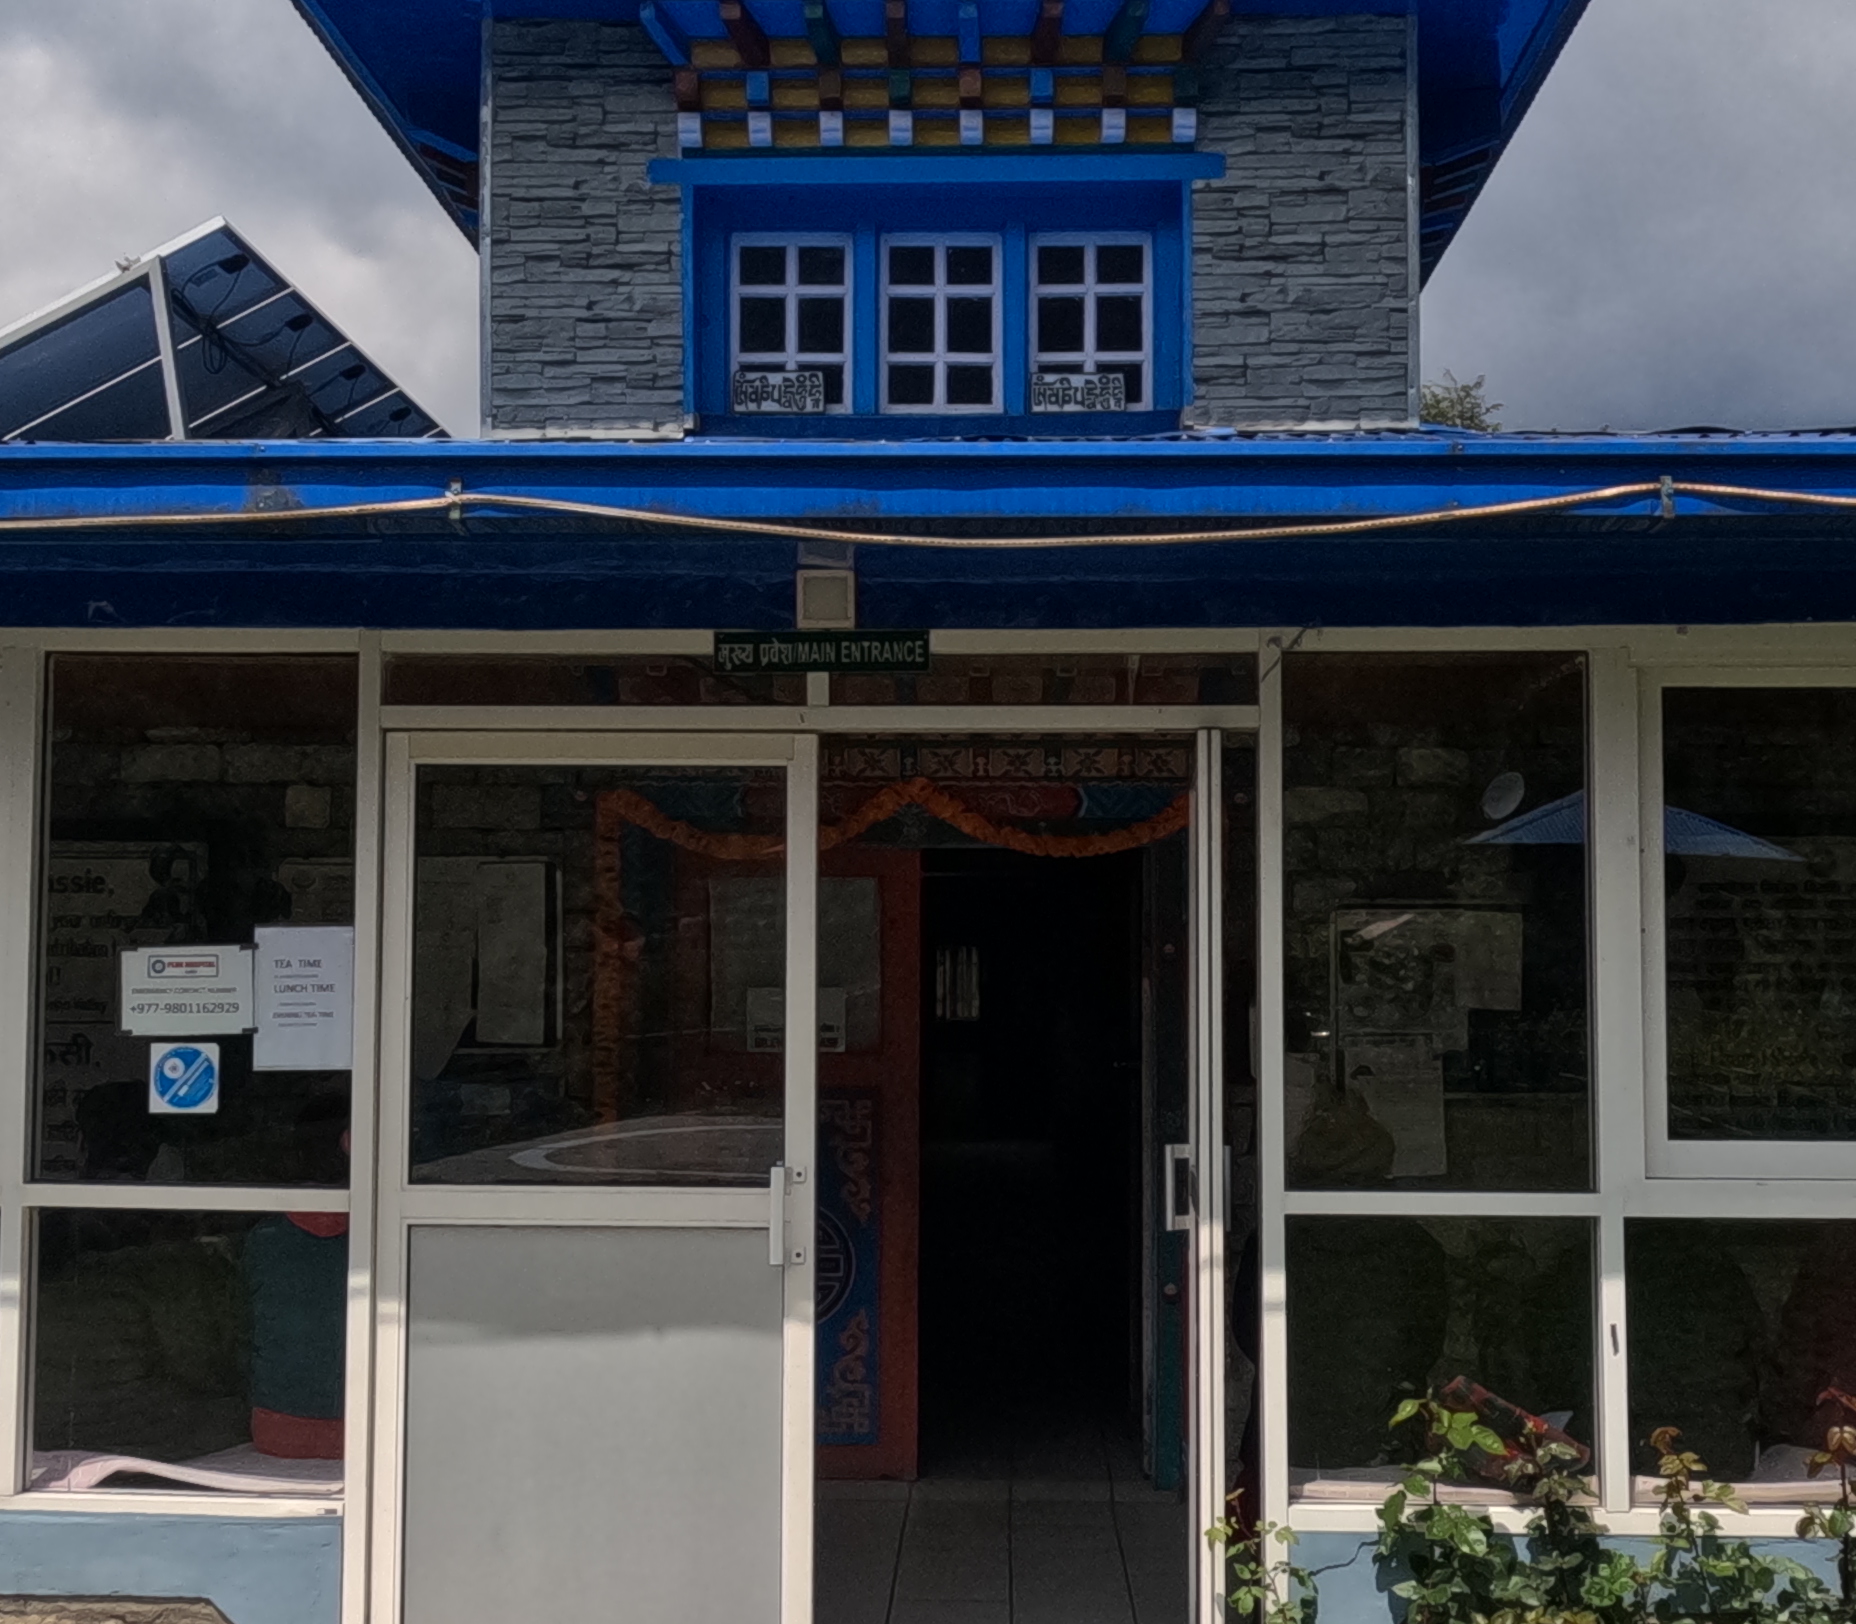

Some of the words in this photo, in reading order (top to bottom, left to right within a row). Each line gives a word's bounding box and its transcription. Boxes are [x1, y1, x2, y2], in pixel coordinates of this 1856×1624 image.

[841, 641, 925, 663] ENTRANCE
[274, 959, 292, 968] TEA
[298, 959, 322, 968] TIME
[274, 983, 308, 993] LUNCH
[310, 983, 336, 993] TIME
[129, 1001, 240, 1014] +977-9801162929
